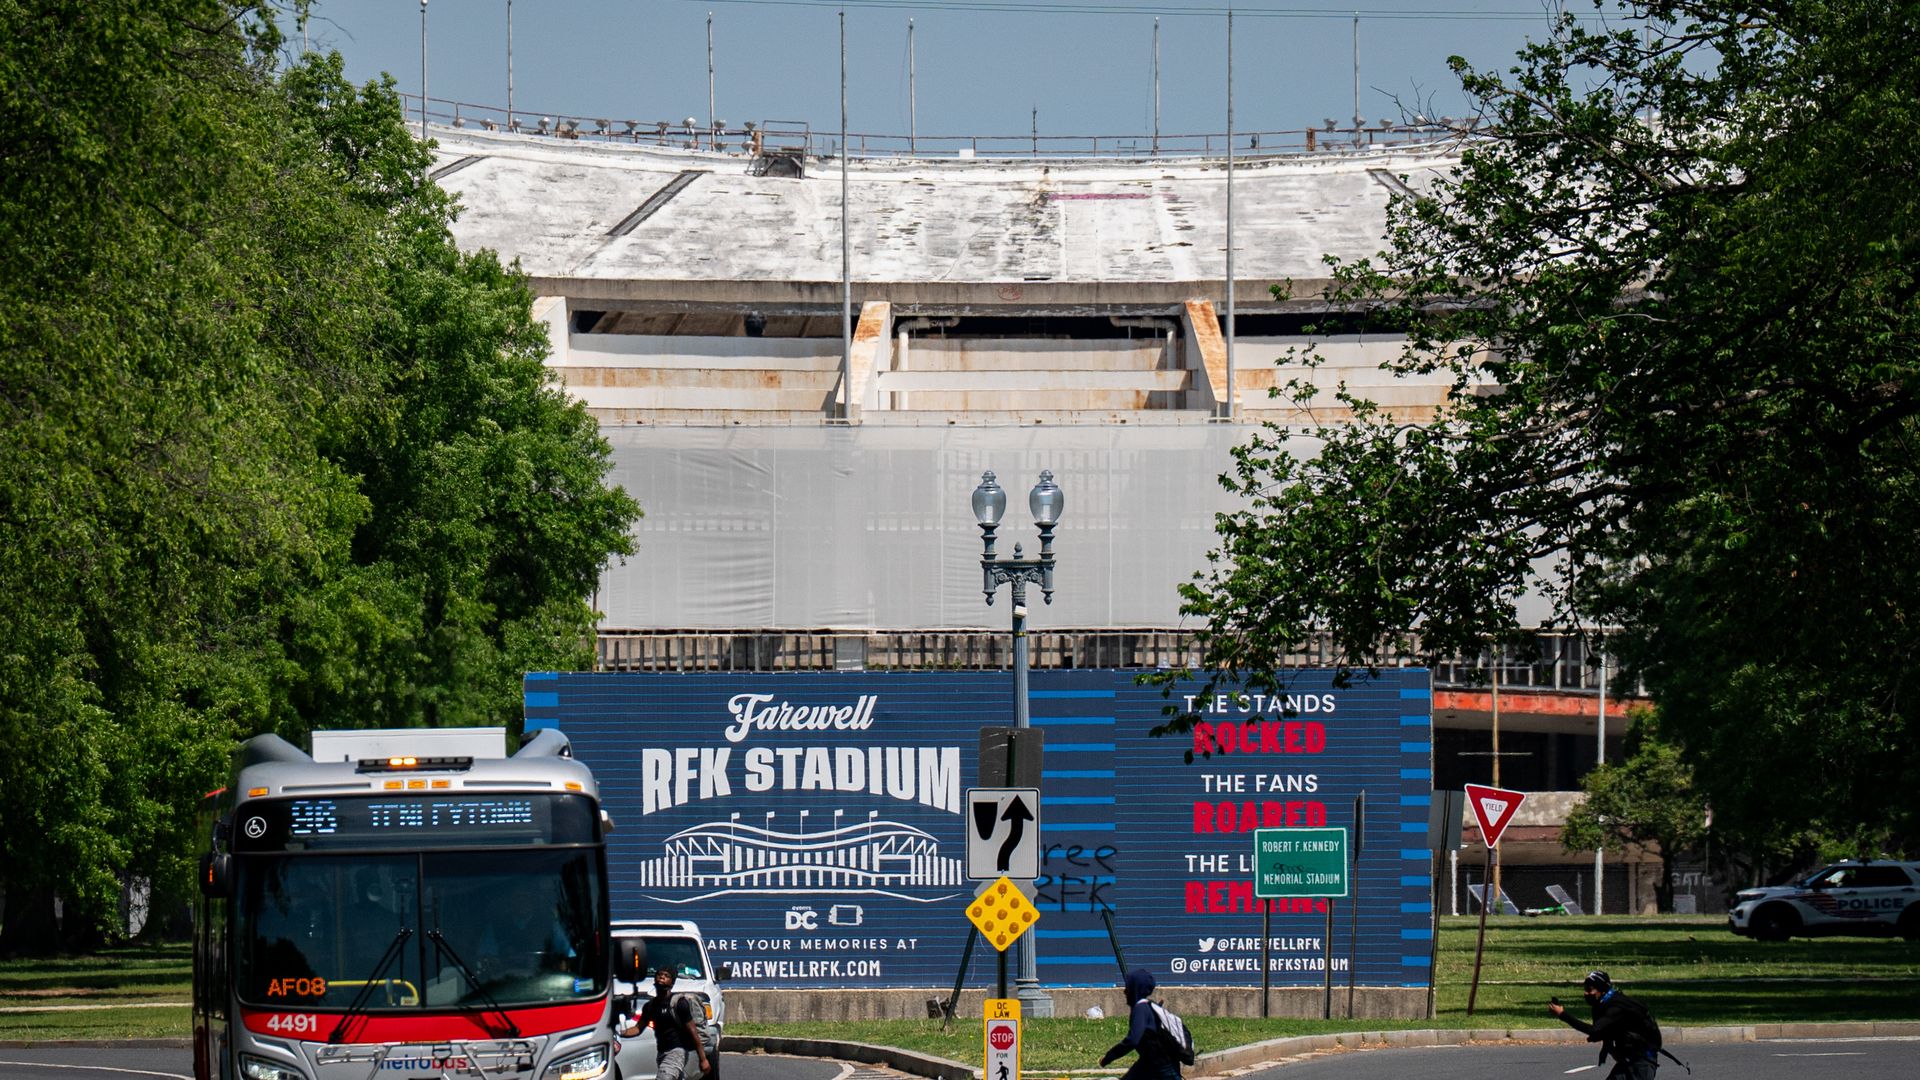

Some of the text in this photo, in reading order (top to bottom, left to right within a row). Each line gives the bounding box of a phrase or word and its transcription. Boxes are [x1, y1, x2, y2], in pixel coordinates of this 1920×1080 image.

[1237, 694, 1336, 713] STANDS
[725, 693, 878, 743] Farewell
[1193, 721, 1326, 754] ROCKED
[642, 747, 961, 816] RFK STADIUM
[1201, 774, 1318, 793] THE FANS
[1485, 802, 1503, 812] YIELD
[1193, 801, 1327, 834] ROARED
[1262, 841, 1293, 853] ROBERT
[1185, 855, 1229, 873] THE
[1263, 873, 1340, 885] MEMORIAL STADIUM
[1837, 897, 1905, 911] POLICE
[785, 911, 818, 930] DC
[747, 939, 792, 951] YOUR
[800, 938, 888, 951] MEMORIES
[896, 938, 918, 950] AT
[1217, 938, 1321, 951] @FAREELLRFK
[1189, 958, 1349, 973] @FAREWELRFKSTADUM
[996, 1002, 1008, 1010] DC
[993, 1011, 1010, 1019] LAW
[266, 1014, 317, 1032] 4491
[991, 1033, 1014, 1043] STOP
